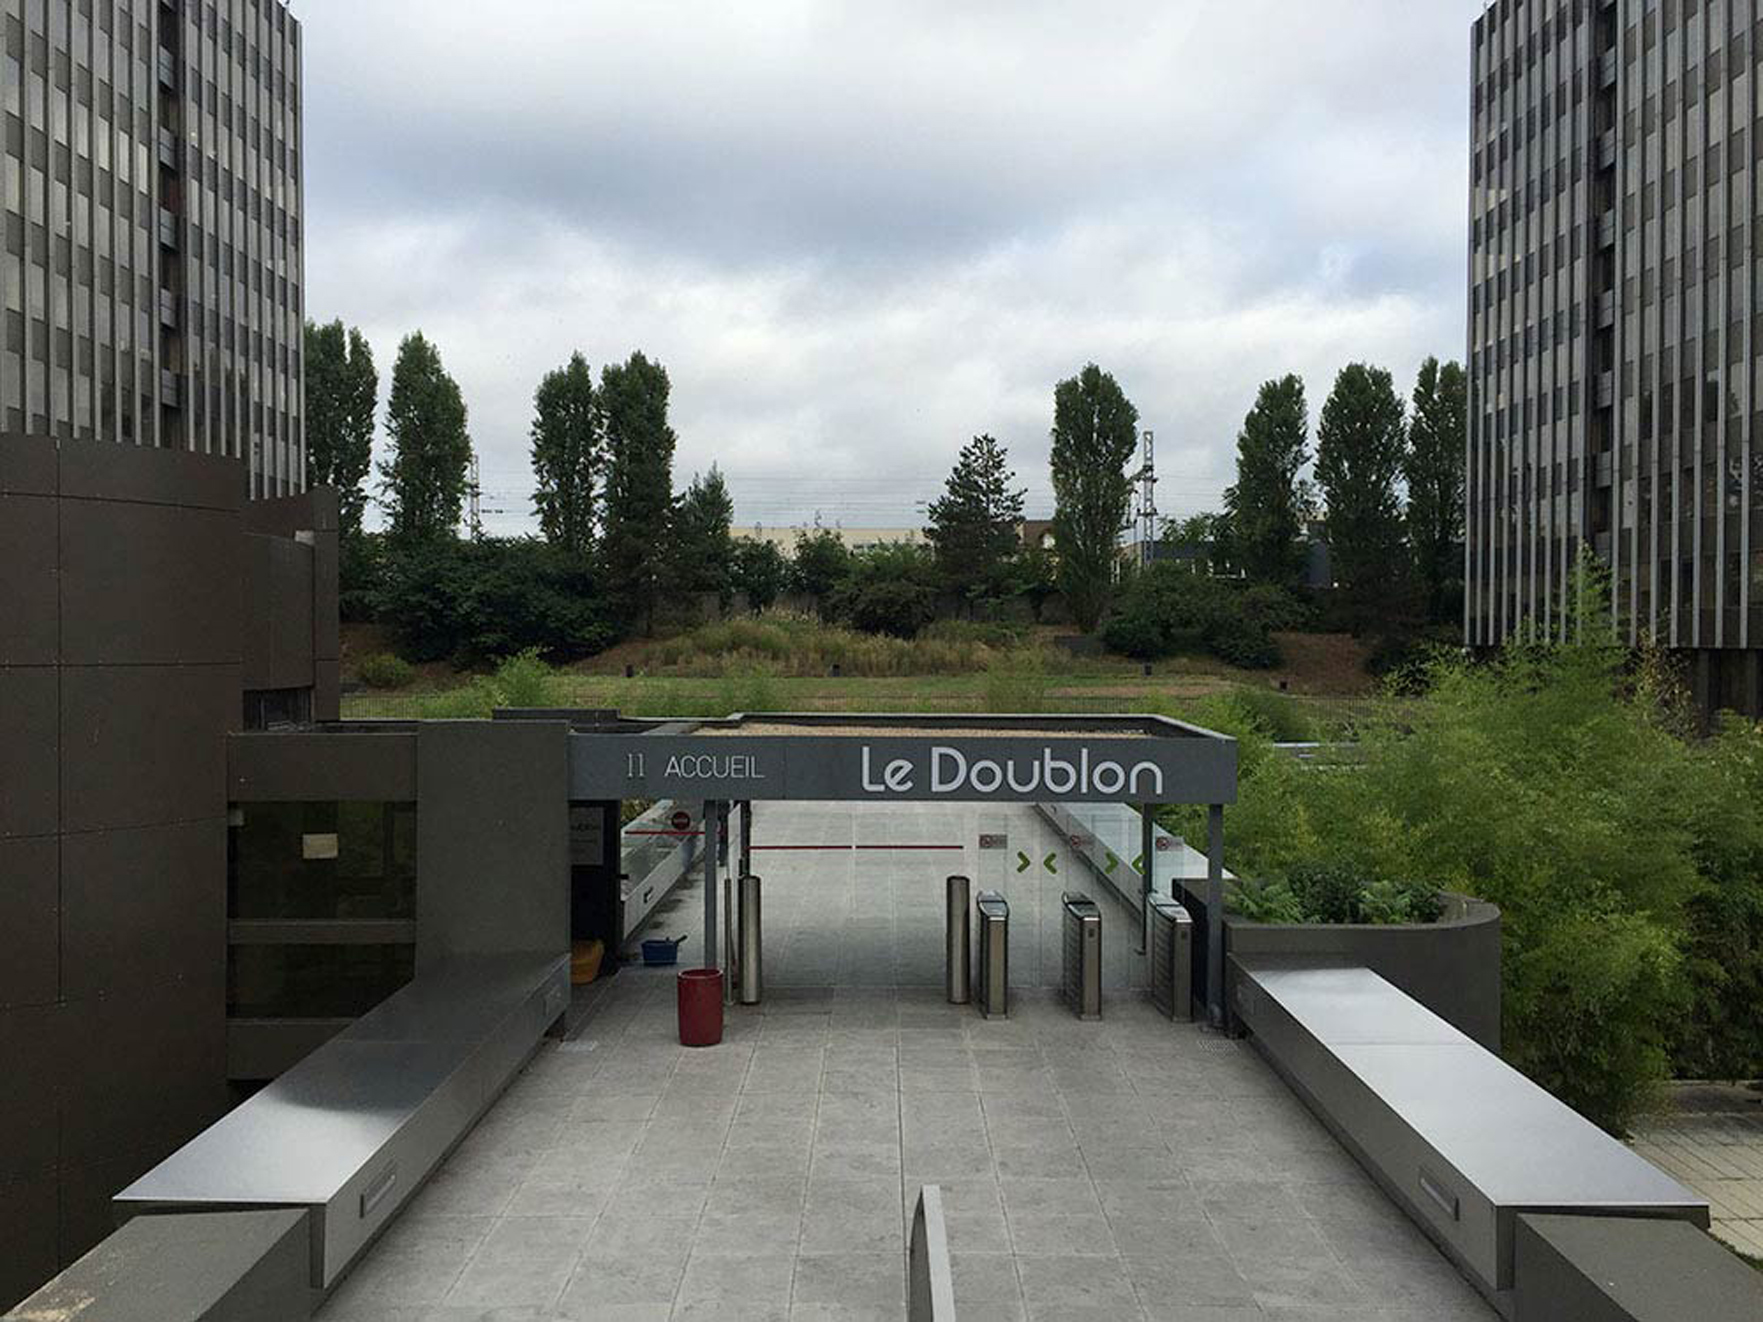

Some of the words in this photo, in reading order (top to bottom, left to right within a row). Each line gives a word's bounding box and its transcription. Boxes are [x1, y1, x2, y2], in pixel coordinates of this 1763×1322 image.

[664, 755, 766, 779] ACCUEIL
[862, 746, 914, 792] Le
[931, 746, 1163, 794] Doublon
